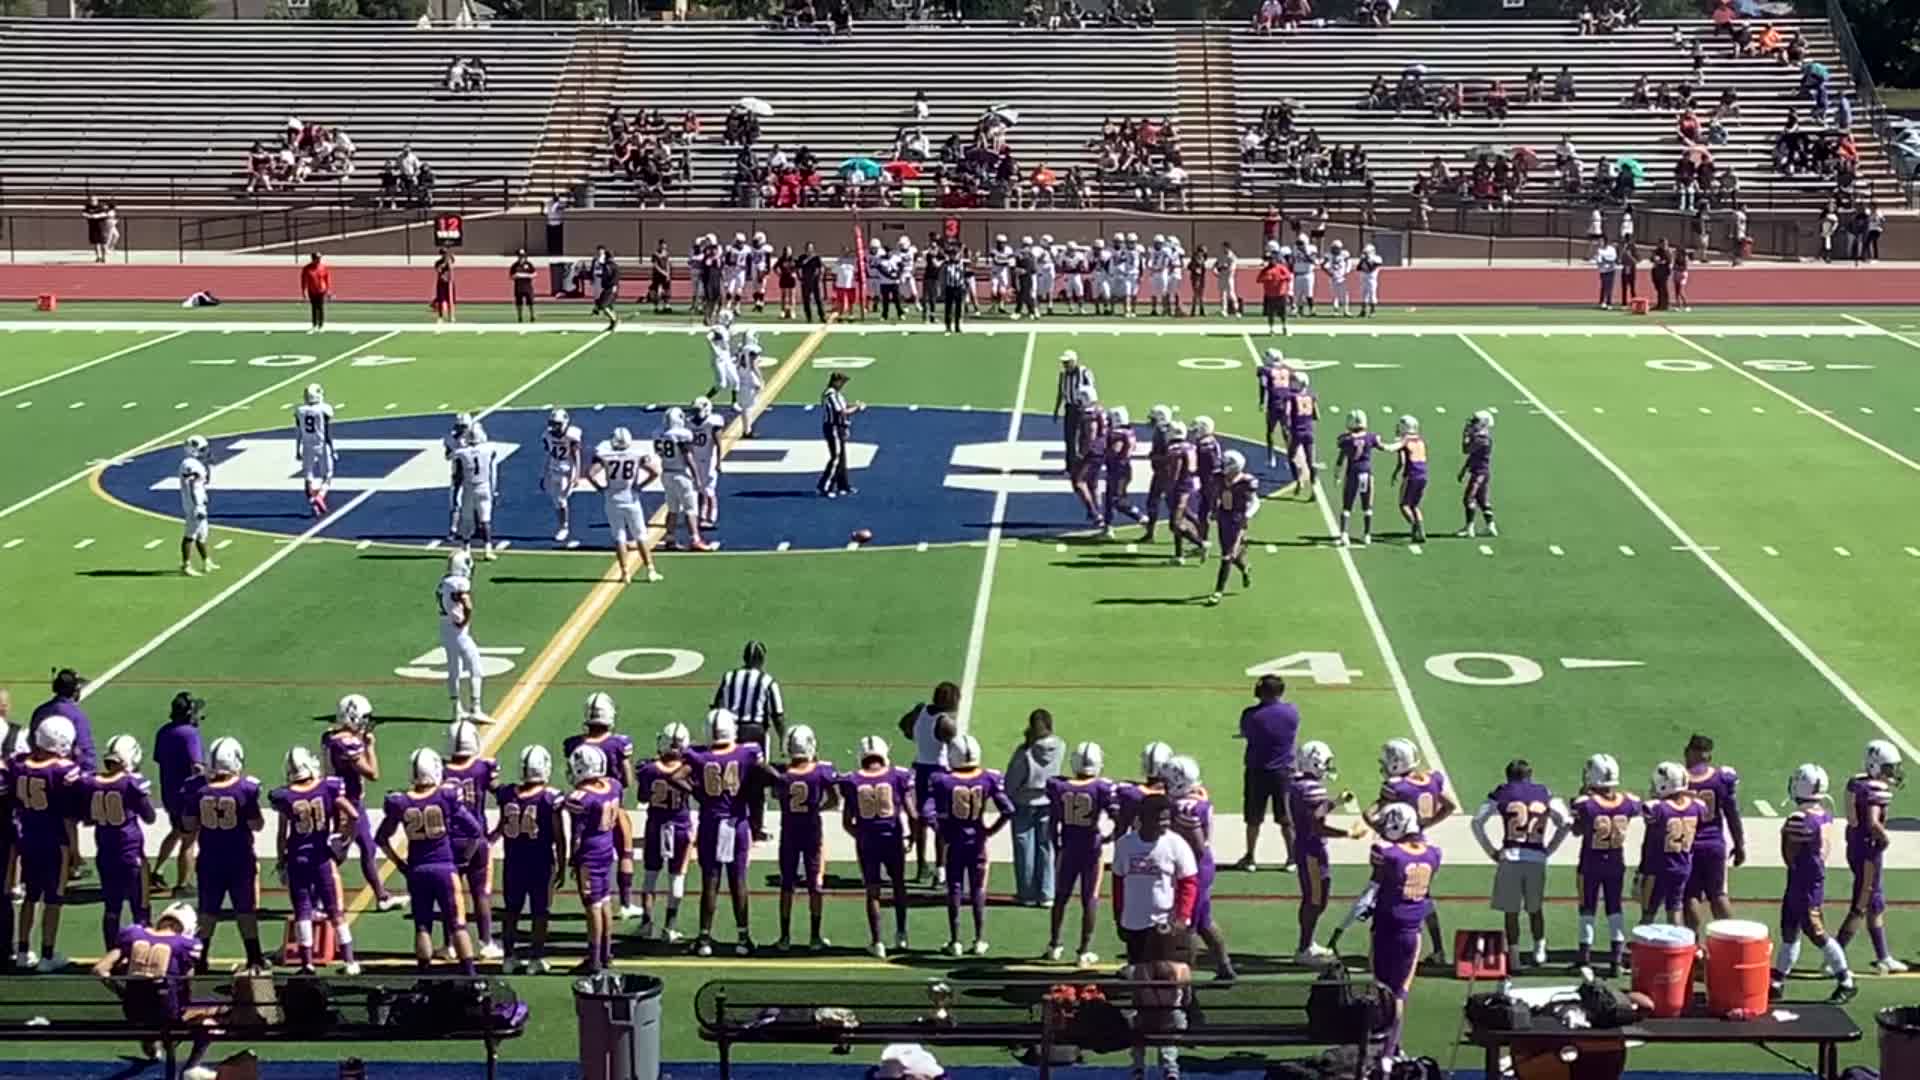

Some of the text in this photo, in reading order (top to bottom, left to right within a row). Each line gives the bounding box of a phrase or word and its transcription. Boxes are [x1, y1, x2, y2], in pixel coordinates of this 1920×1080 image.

[304, 414, 317, 434] 9
[550, 445, 567, 462] 42
[472, 457, 480, 476] 1
[607, 460, 636, 481] 78
[702, 760, 740, 797] 64
[789, 780, 810, 814] 2
[1505, 801, 1549, 842] 22
